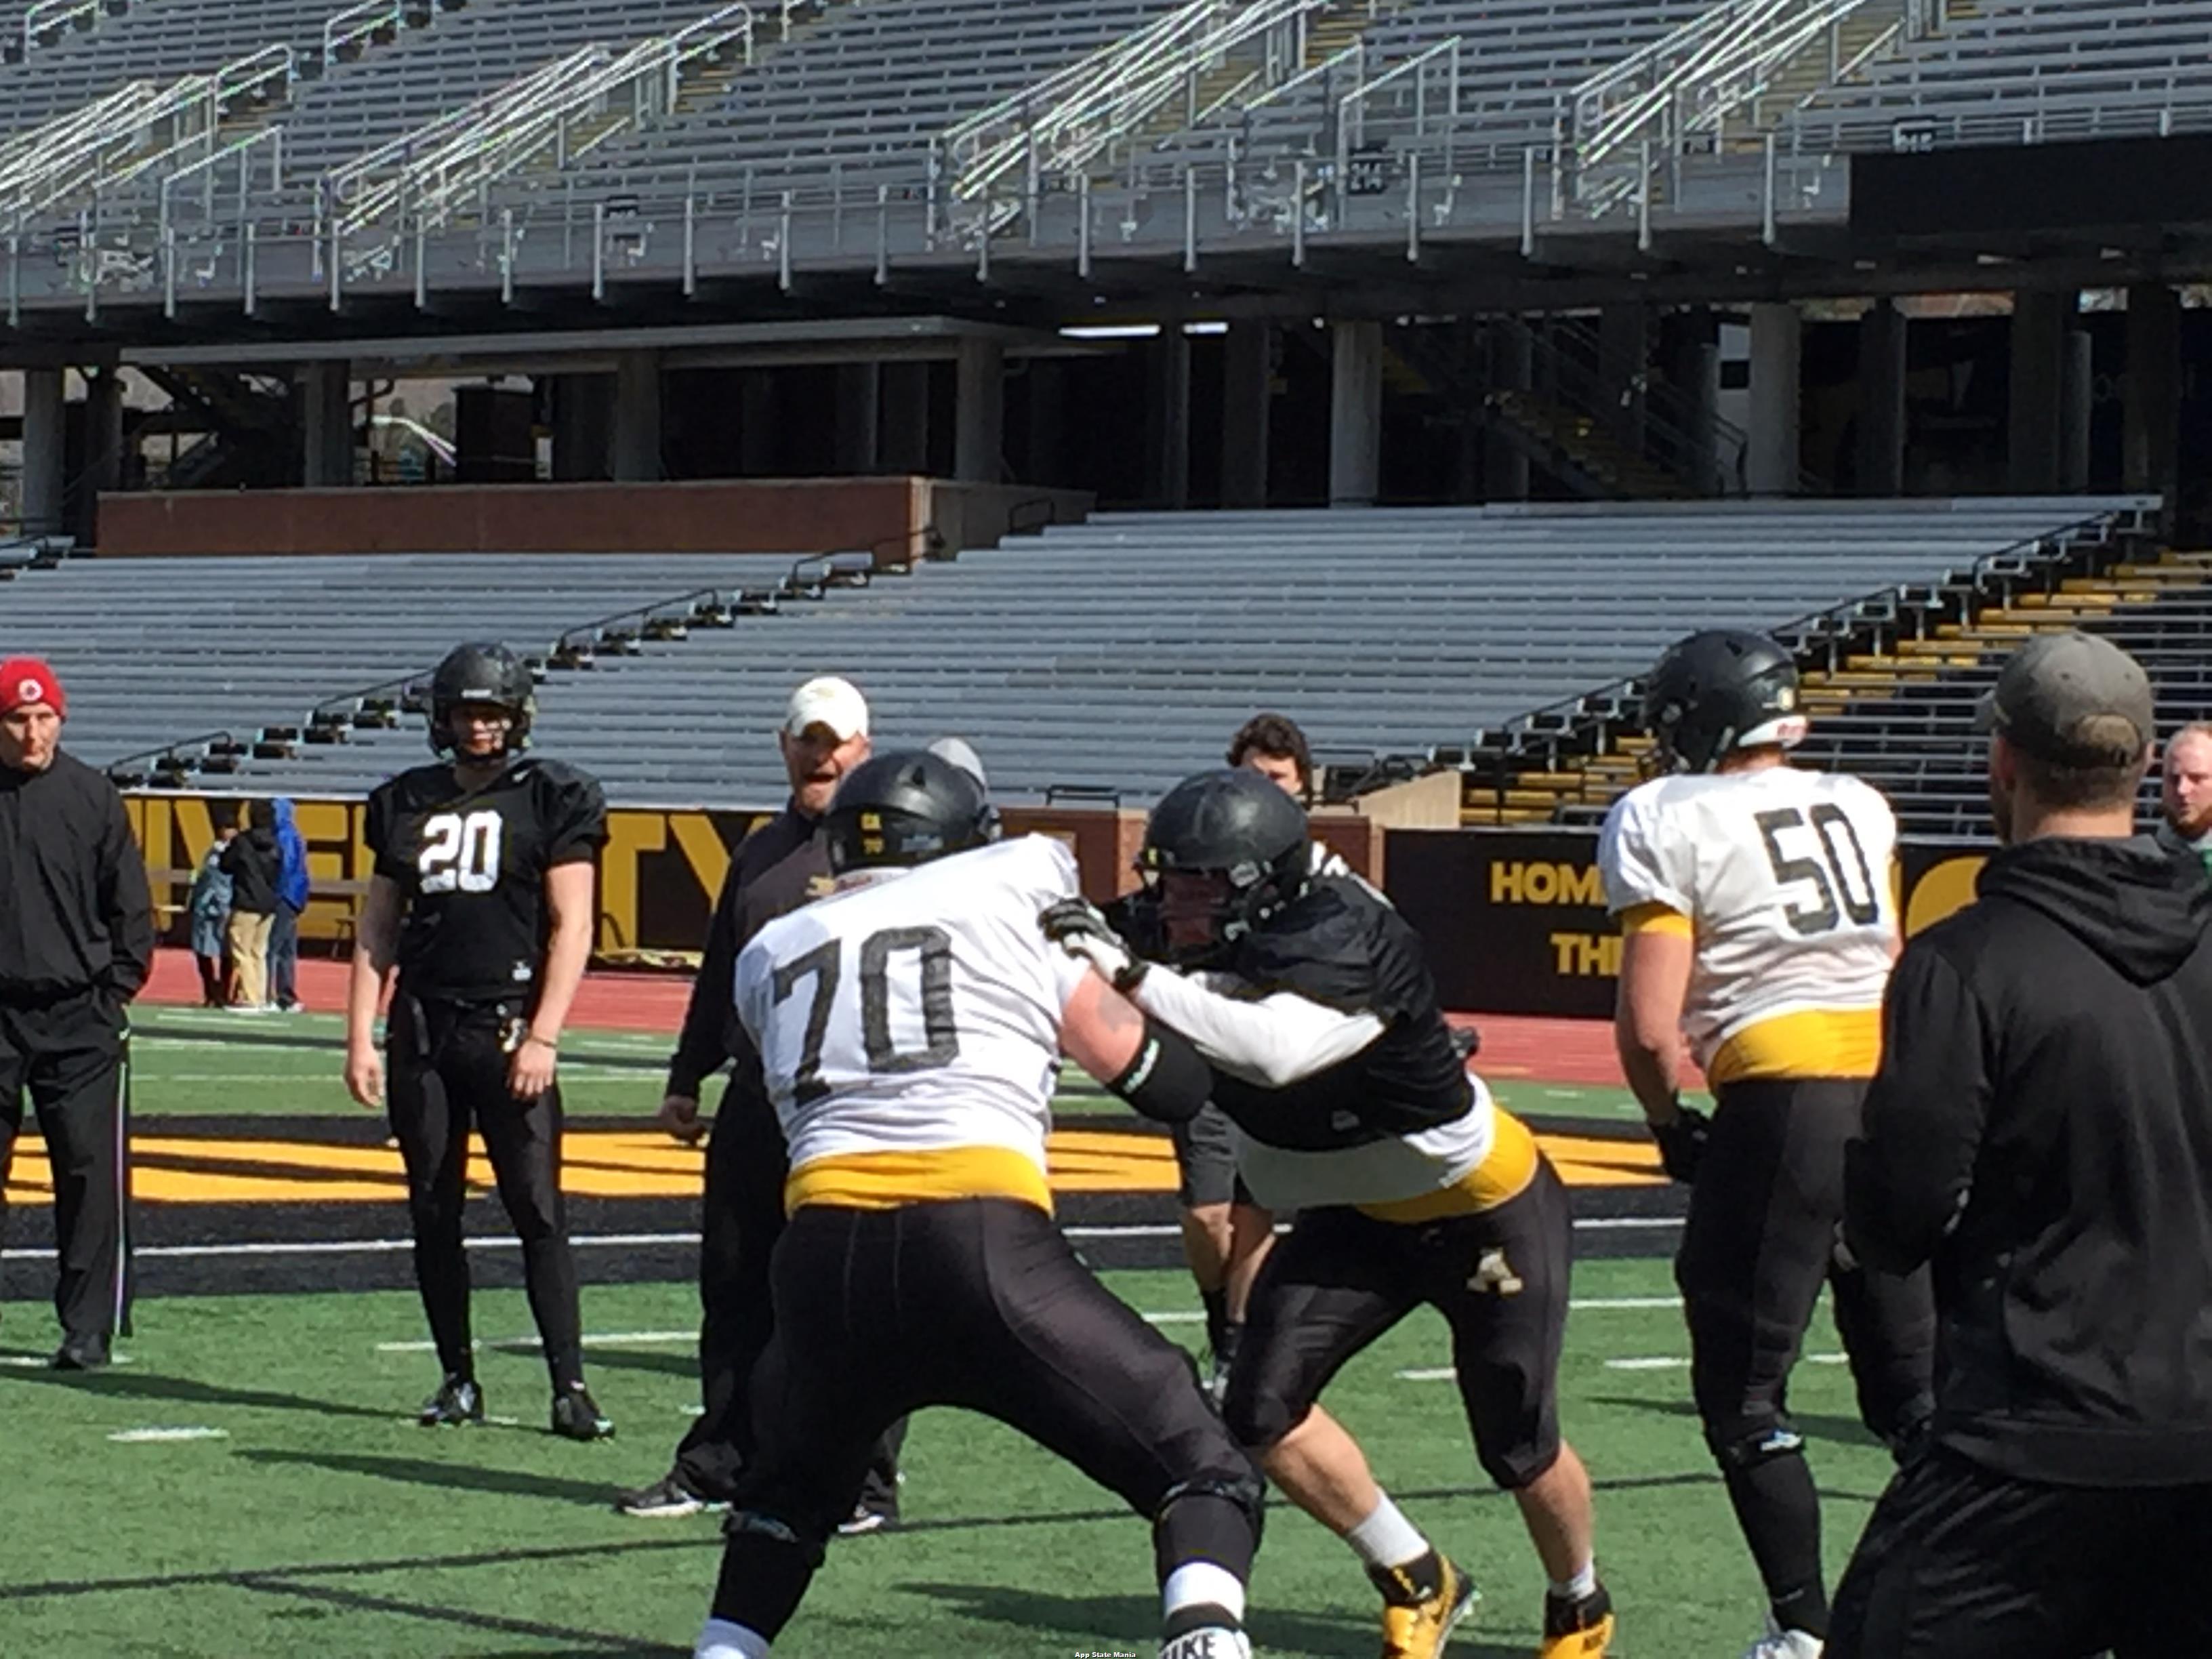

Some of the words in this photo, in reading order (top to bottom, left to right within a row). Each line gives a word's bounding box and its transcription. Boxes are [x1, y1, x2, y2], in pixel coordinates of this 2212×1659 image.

[419, 811, 502, 893] 20
[1491, 861, 1609, 905] HOM
[1754, 802, 1879, 935] 50
[773, 926, 960, 1109] 70
